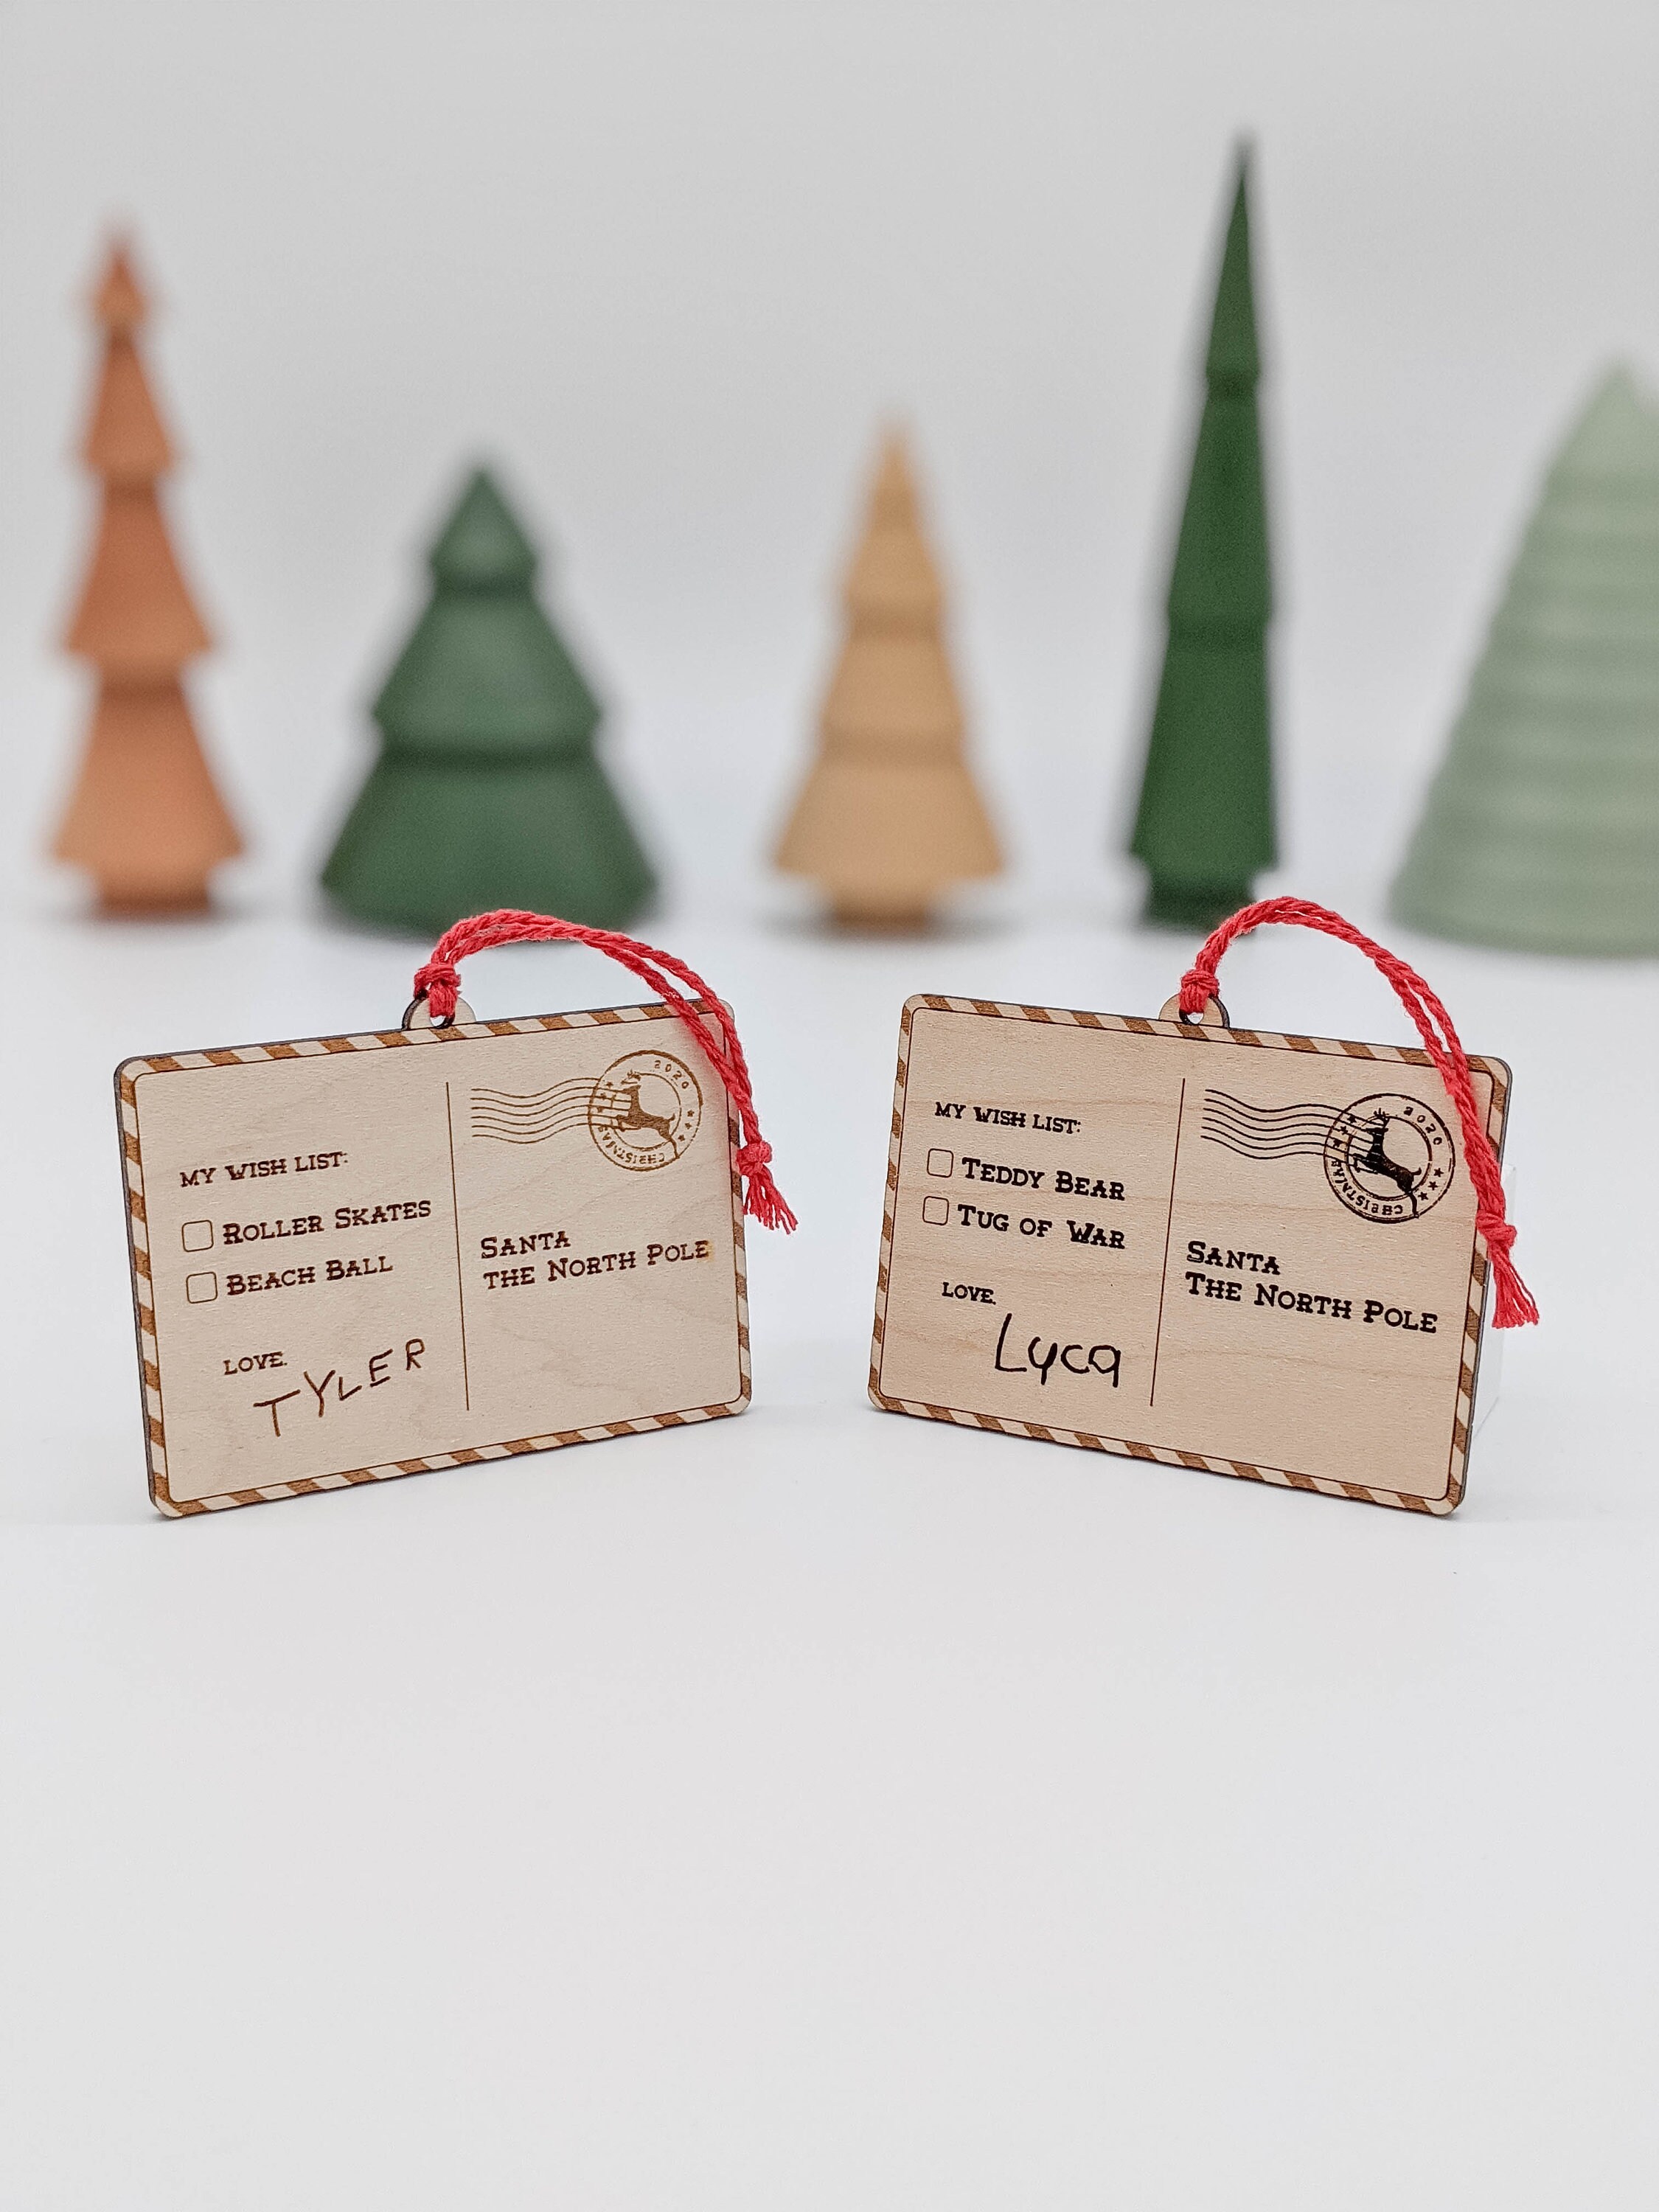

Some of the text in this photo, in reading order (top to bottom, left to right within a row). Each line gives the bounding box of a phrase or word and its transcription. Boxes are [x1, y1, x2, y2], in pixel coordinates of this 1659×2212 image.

[654, 1060, 689, 1089] 2020
[934, 1101, 1082, 1135] MY WISH LIST:
[1403, 1107, 1443, 1145] 2020
[179, 1151, 348, 1188] MY WISH LIST:
[961, 1157, 1126, 1201] TEDDY BEAR
[222, 1200, 431, 1245] ROLLER SKATES
[957, 1204, 1126, 1250] TUG OF WAR
[480, 1231, 571, 1259] SANTA
[482, 1239, 710, 1290] THE NORTH POLE
[1186, 1240, 1281, 1276] SANTA
[226, 1256, 394, 1296] BEACH BALL
[1185, 1270, 1439, 1334] THE NORTH POLE
[253, 1338, 425, 1437] TYLER
